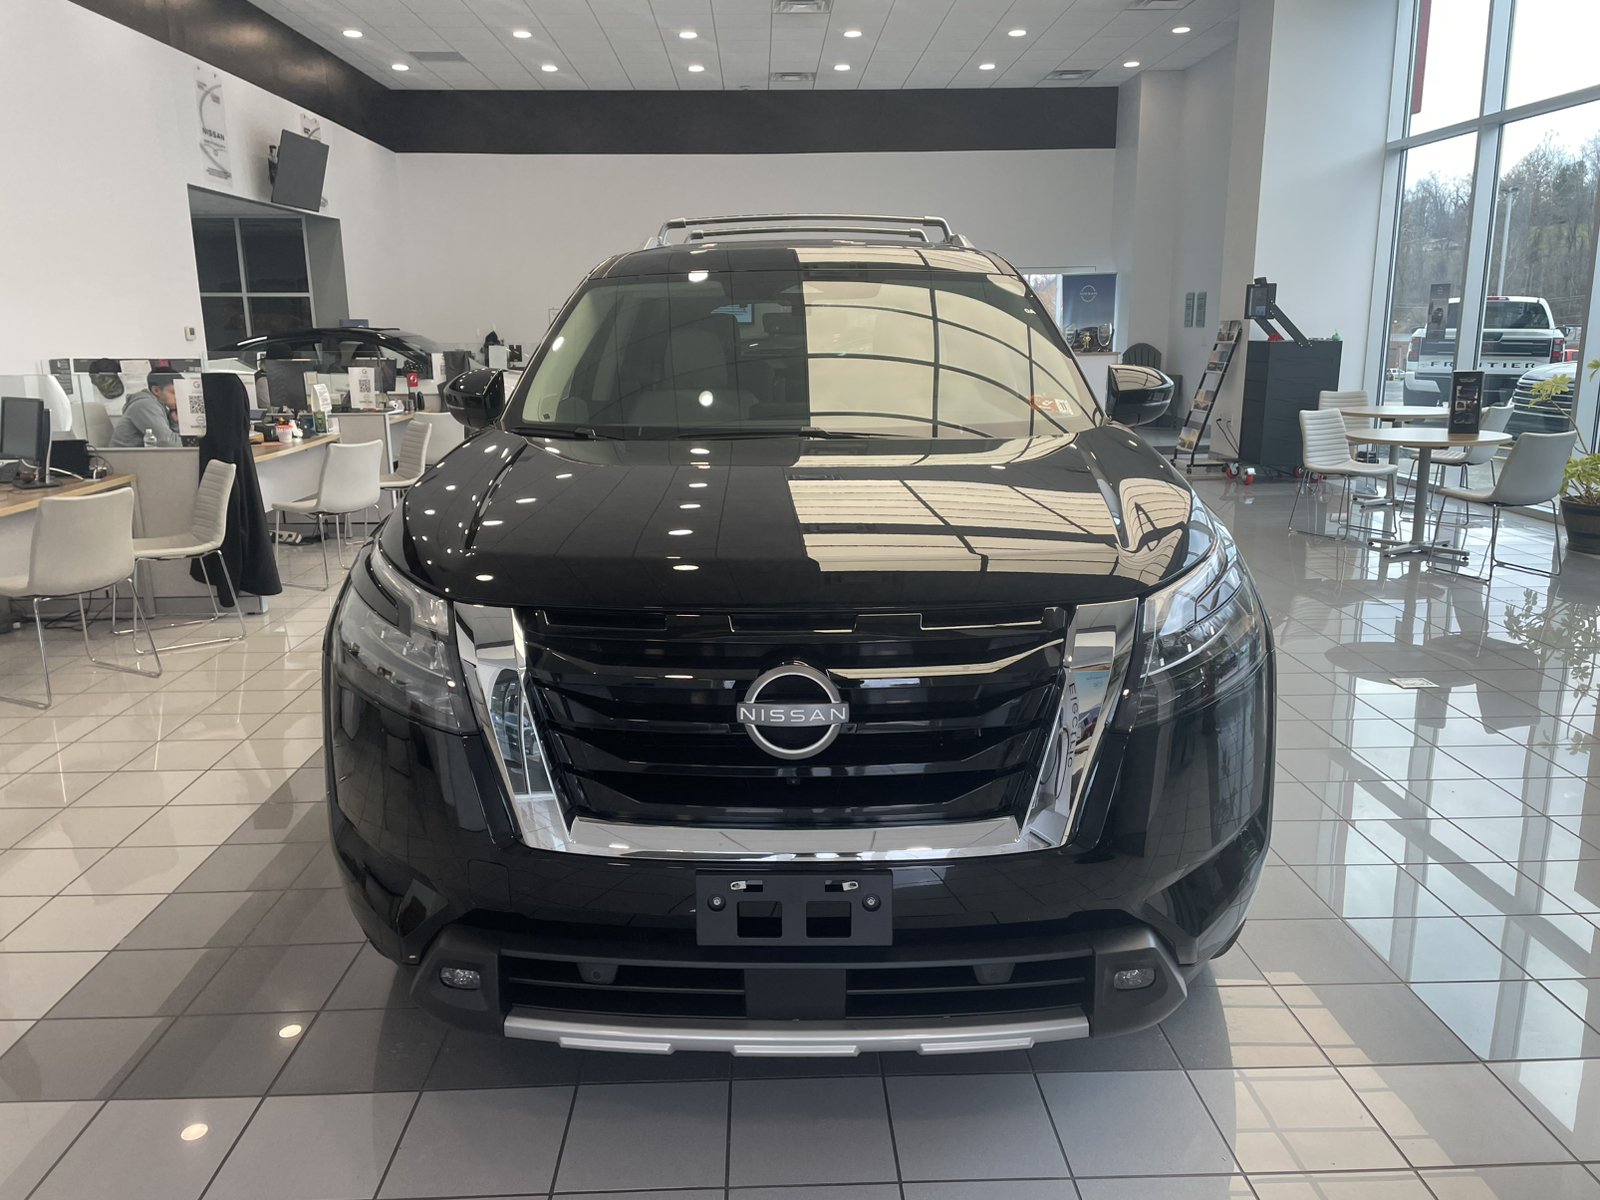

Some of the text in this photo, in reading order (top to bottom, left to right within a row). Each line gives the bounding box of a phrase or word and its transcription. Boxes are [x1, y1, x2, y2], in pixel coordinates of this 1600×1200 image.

[202, 127, 225, 141] NISSAN
[1430, 361, 1535, 369] FRTIER
[739, 706, 846, 722] NISSAN
